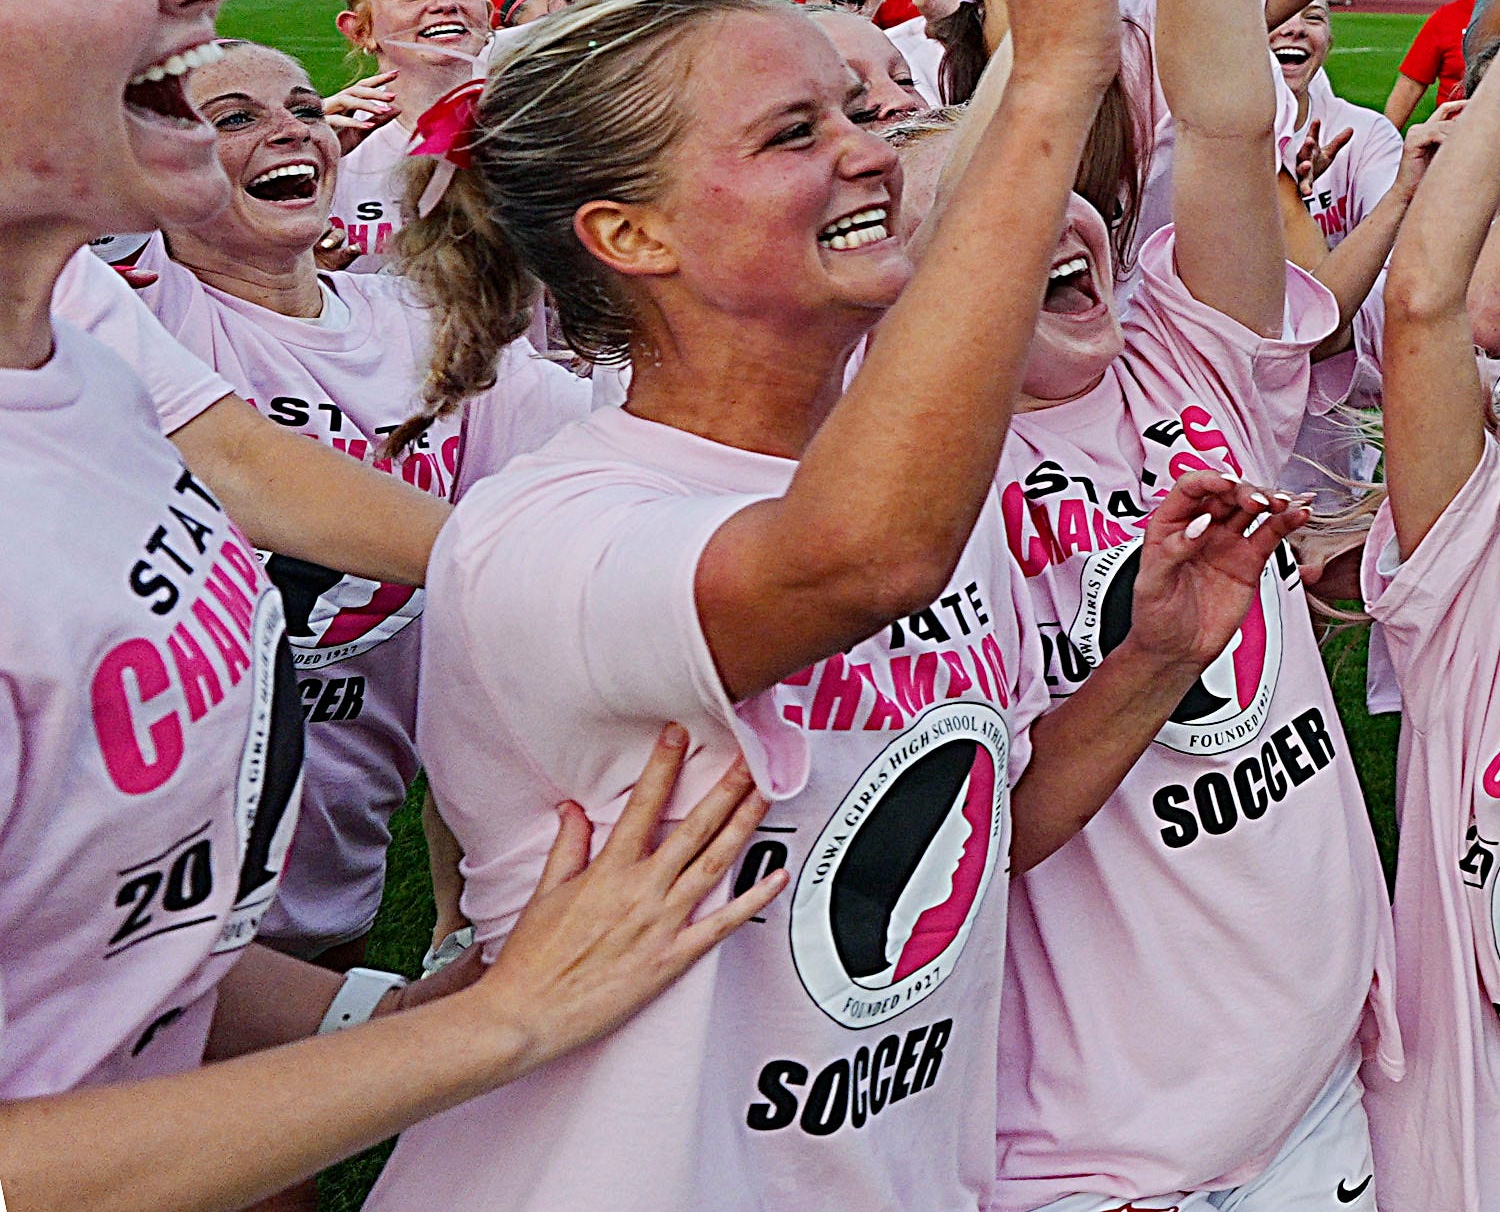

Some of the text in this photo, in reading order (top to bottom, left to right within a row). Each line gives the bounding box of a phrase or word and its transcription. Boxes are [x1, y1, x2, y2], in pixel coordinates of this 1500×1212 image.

[1084, 579, 1102, 628] GIRLS
[326, 645, 359, 661] 1927
[1079, 633, 1097, 666] OWA
[1190, 684, 1271, 748] FOUNDED 1927
[812, 834, 848, 885] IOWA
[845, 768, 889, 828] GIRLS
[889, 731, 931, 770] HIGH
[931, 715, 978, 741] SCHOOL
[1152, 707, 1336, 849] SOCCER
[108, 839, 213, 945] 20
[842, 966, 941, 1018] FOUNDED 1927
[747, 1017, 953, 1136] SOCCER
